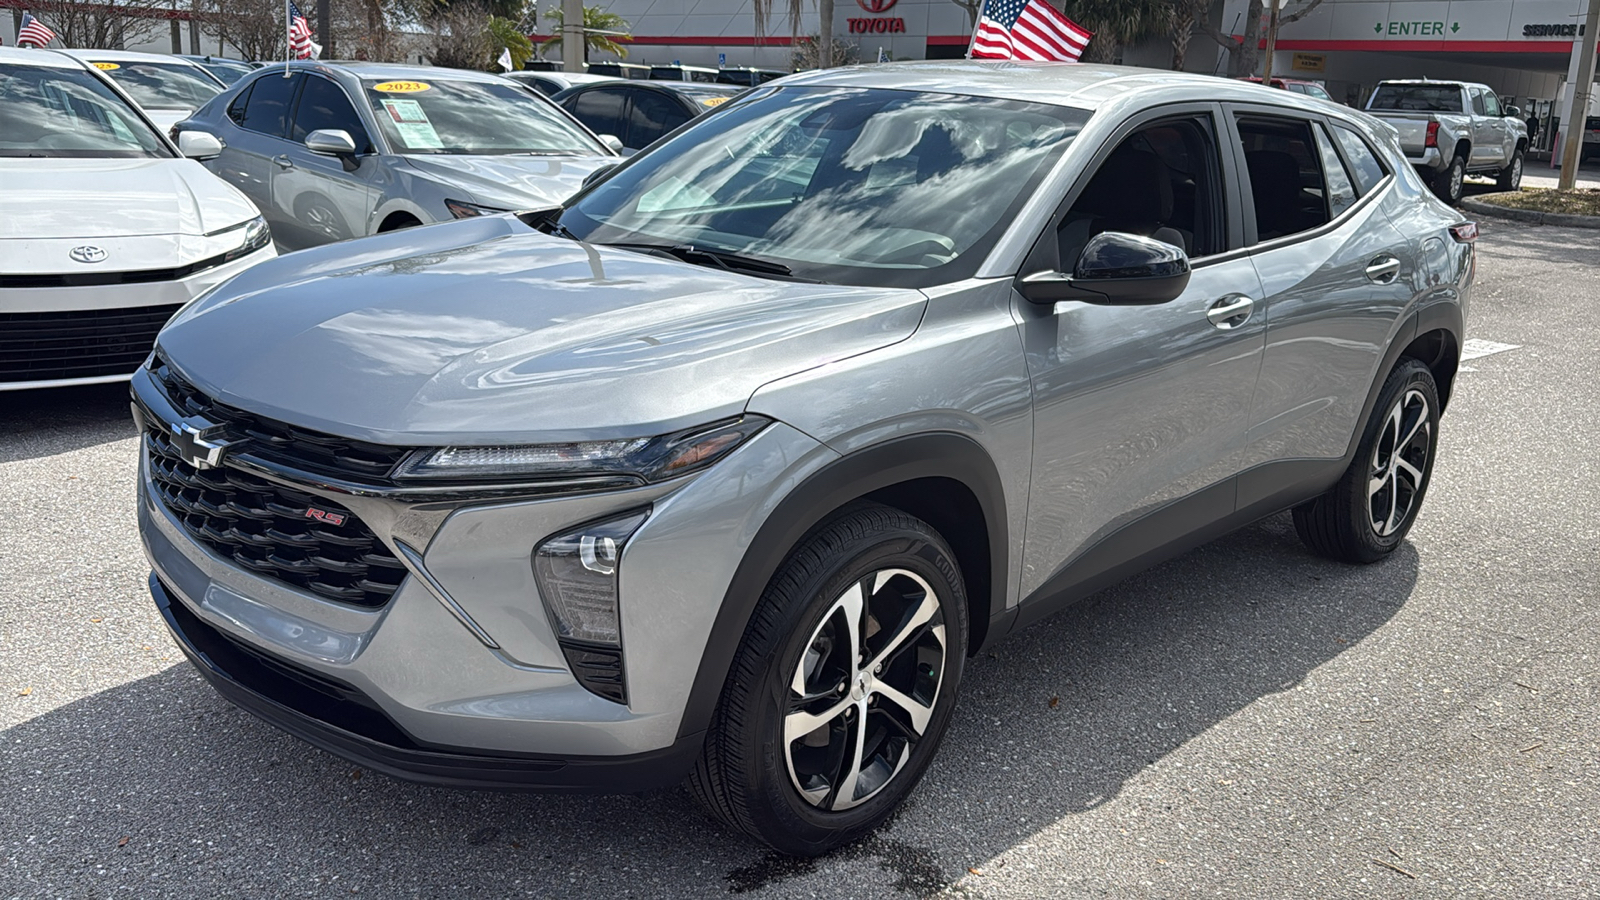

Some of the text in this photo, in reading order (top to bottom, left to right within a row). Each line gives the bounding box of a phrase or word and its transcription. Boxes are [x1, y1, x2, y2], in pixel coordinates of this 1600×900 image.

[846, 17, 906, 34] TOYOTA
[1388, 21, 1444, 36] ENTER
[1522, 24, 1578, 37] SERVICE
[386, 83, 421, 91] 2023
[305, 507, 344, 526] RS
